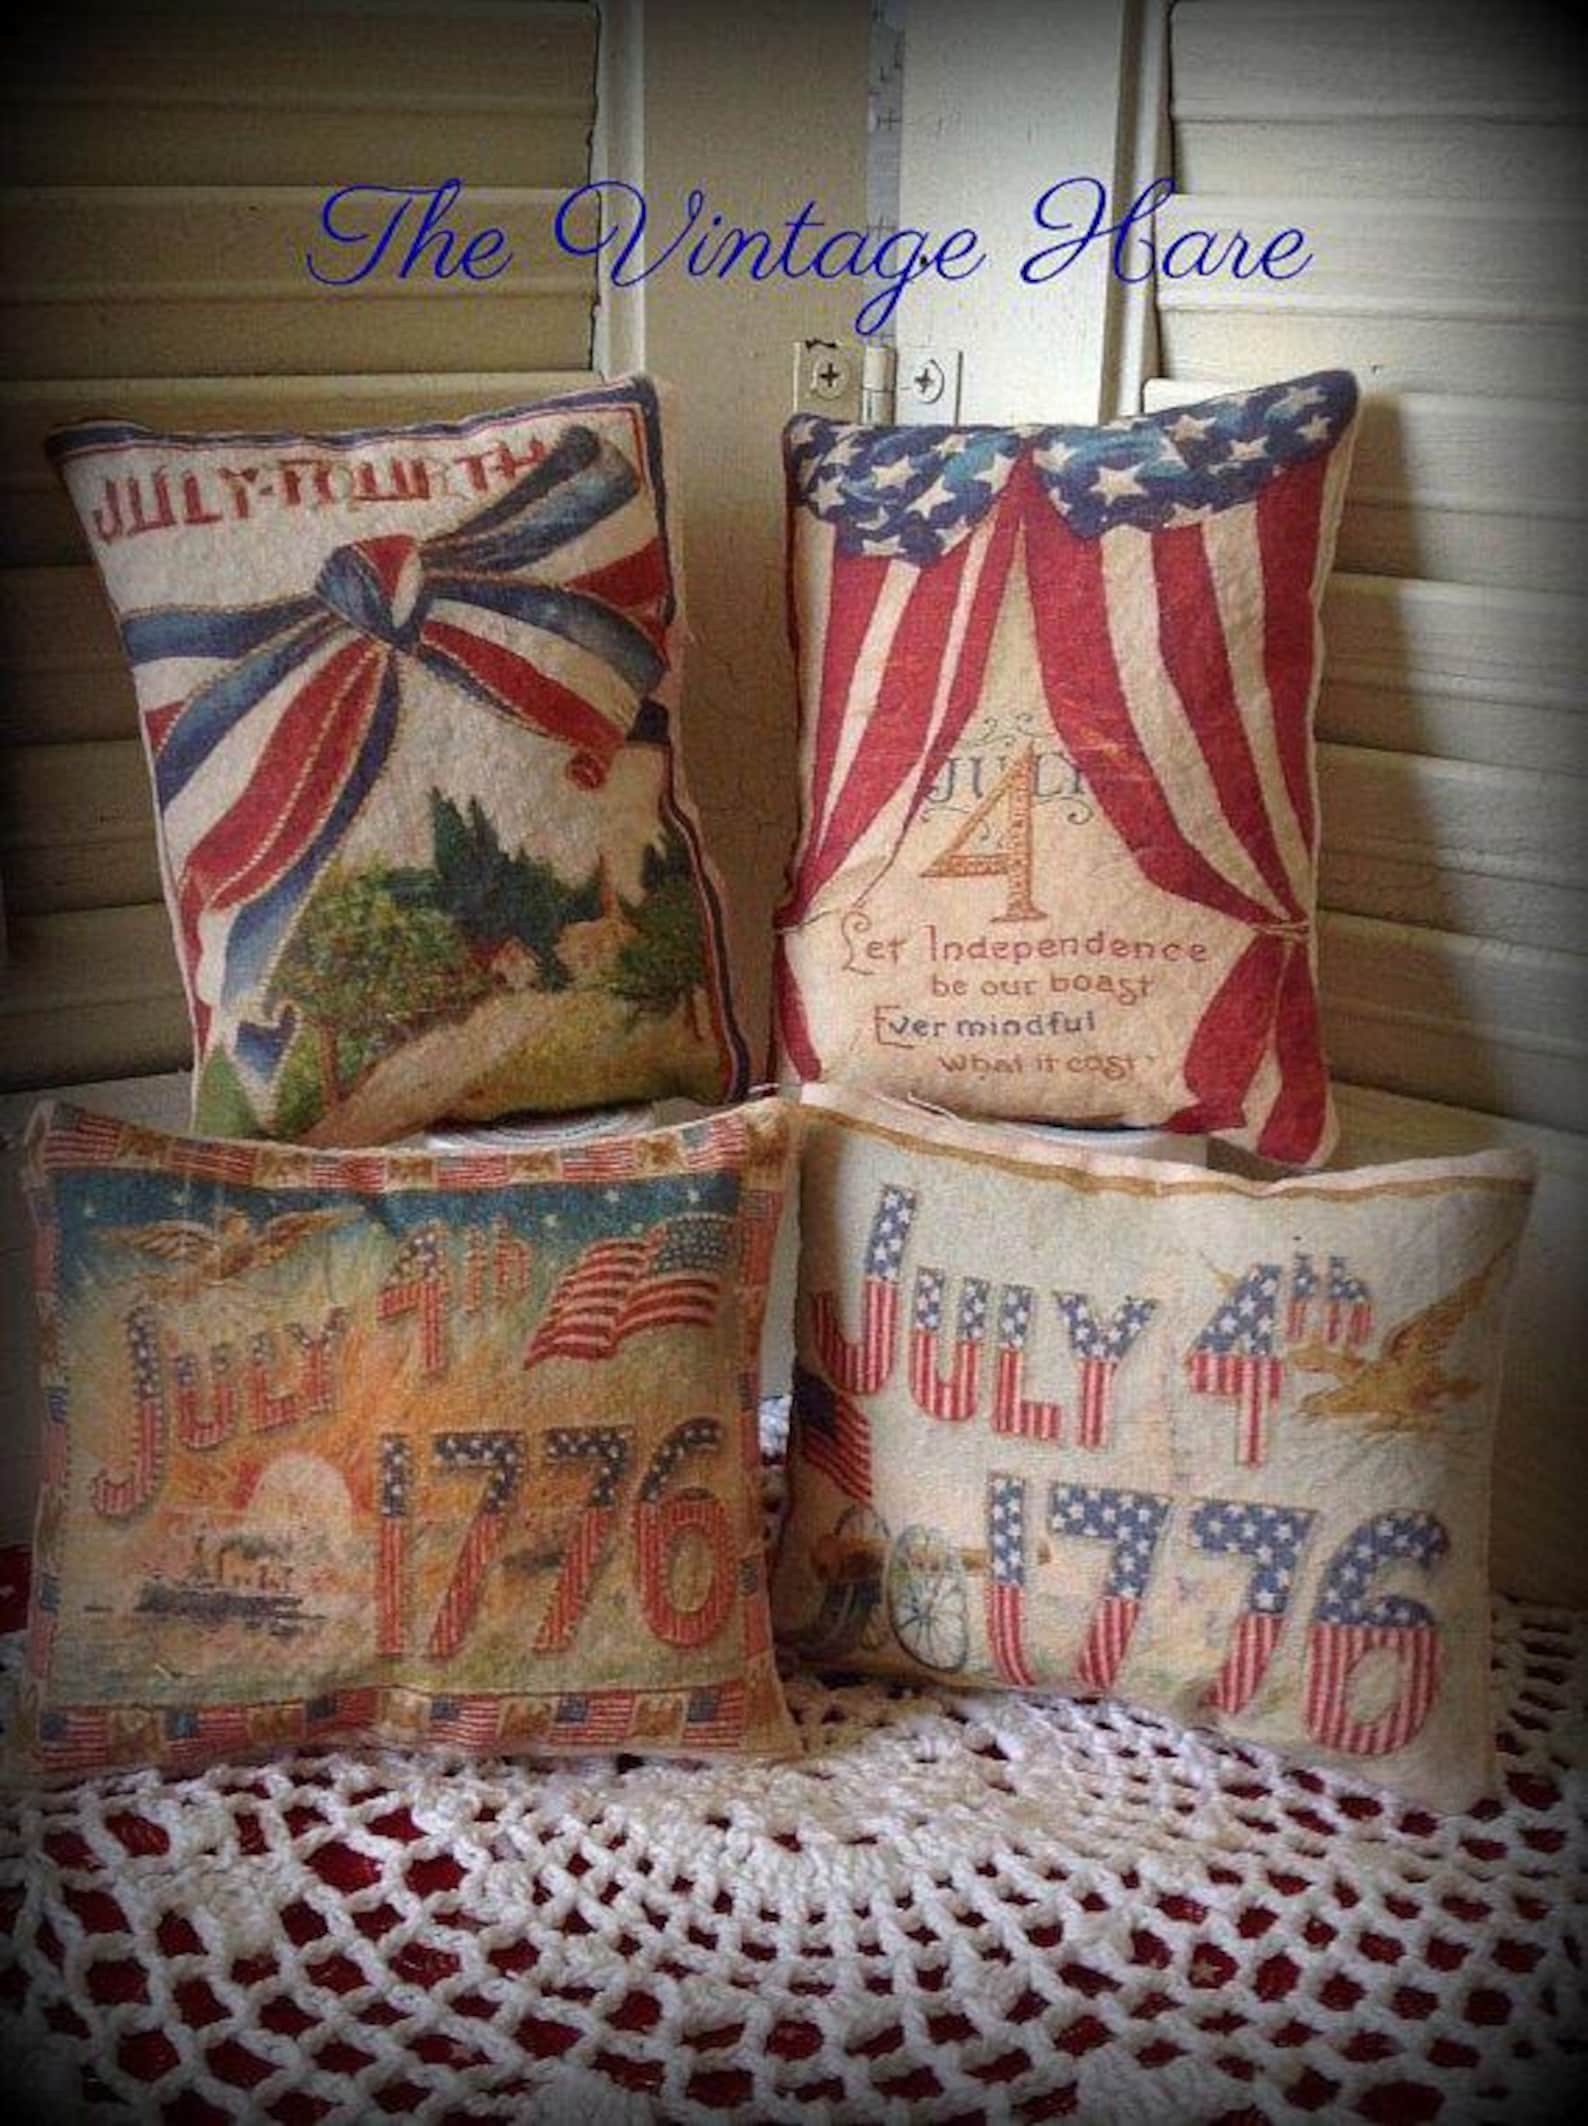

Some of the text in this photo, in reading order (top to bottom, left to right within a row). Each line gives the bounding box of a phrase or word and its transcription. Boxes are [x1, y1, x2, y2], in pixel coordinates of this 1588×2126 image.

[919, 740, 1048, 922] 4
[841, 910, 1209, 975] Let Independence
[932, 972, 1155, 1005] be our boast
[874, 1005, 1096, 1049] Ever mindful
[937, 1053, 1136, 1081] what it cost
[812, 1183, 1156, 1452] JULY
[374, 1417, 737, 1662] 1776
[985, 1471, 1450, 1757] 1776
